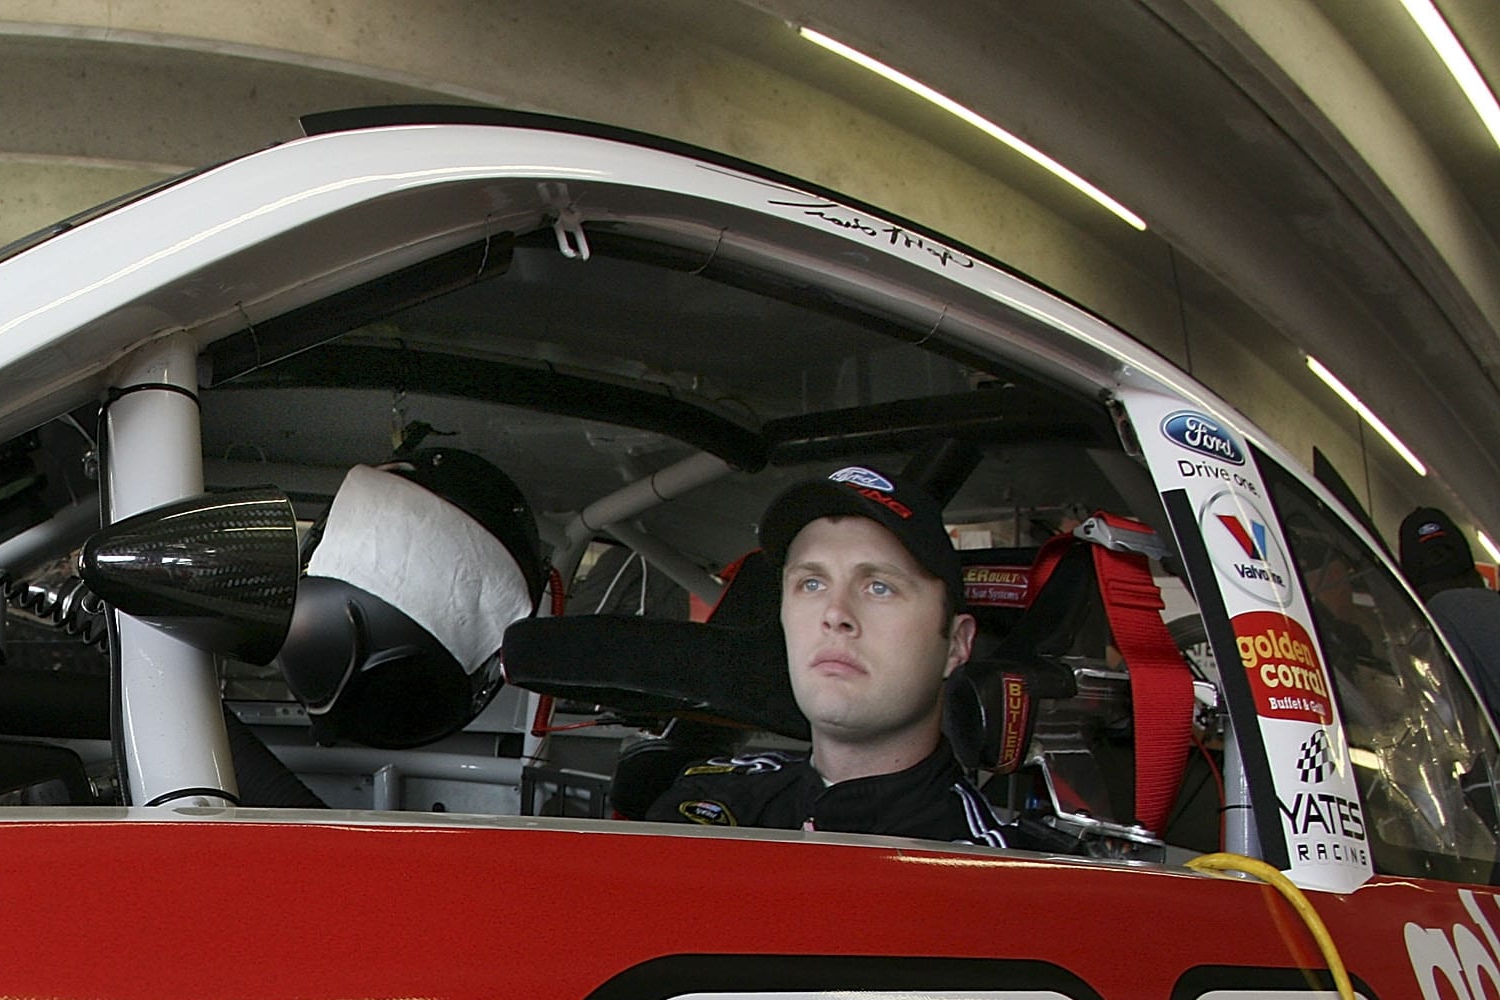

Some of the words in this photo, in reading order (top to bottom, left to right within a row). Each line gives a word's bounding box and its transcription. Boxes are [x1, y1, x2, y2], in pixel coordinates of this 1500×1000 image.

[1184, 416, 1235, 458] Ford
[1177, 459, 1231, 482] Drive
[1236, 629, 1315, 668] golden
[1260, 662, 1328, 699] corral
[1004, 683, 1022, 761] BUTLER
[1268, 696, 1303, 711] Buffet
[1276, 792, 1366, 842] YATES
[1298, 844, 1368, 867] RACING
